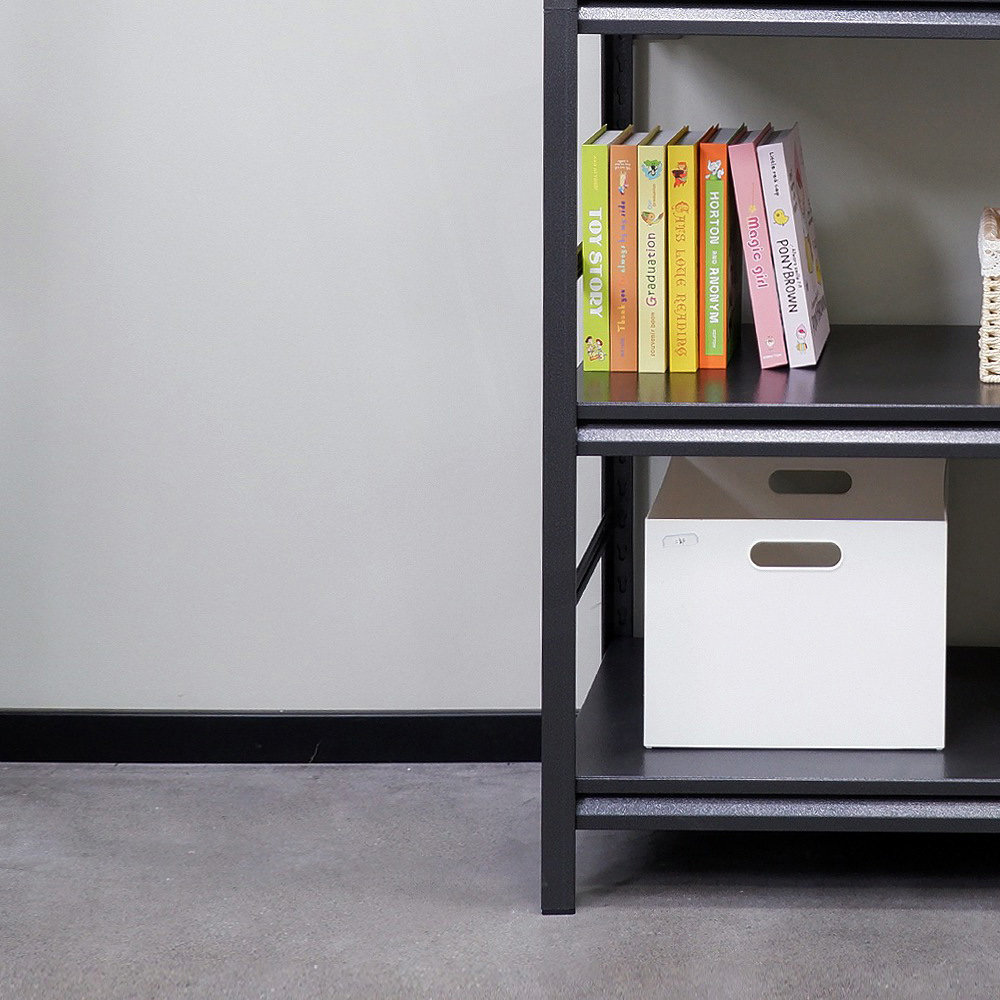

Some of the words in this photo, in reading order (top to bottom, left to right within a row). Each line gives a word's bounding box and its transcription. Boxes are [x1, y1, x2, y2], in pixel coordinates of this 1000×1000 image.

[588, 207, 603, 247] TOY
[709, 191, 720, 244] HORTON
[589, 252, 603, 318] STORY
[646, 233, 657, 307] Graduation
[752, 265, 768, 289] girl
[776, 239, 799, 313] PONYBROWN
